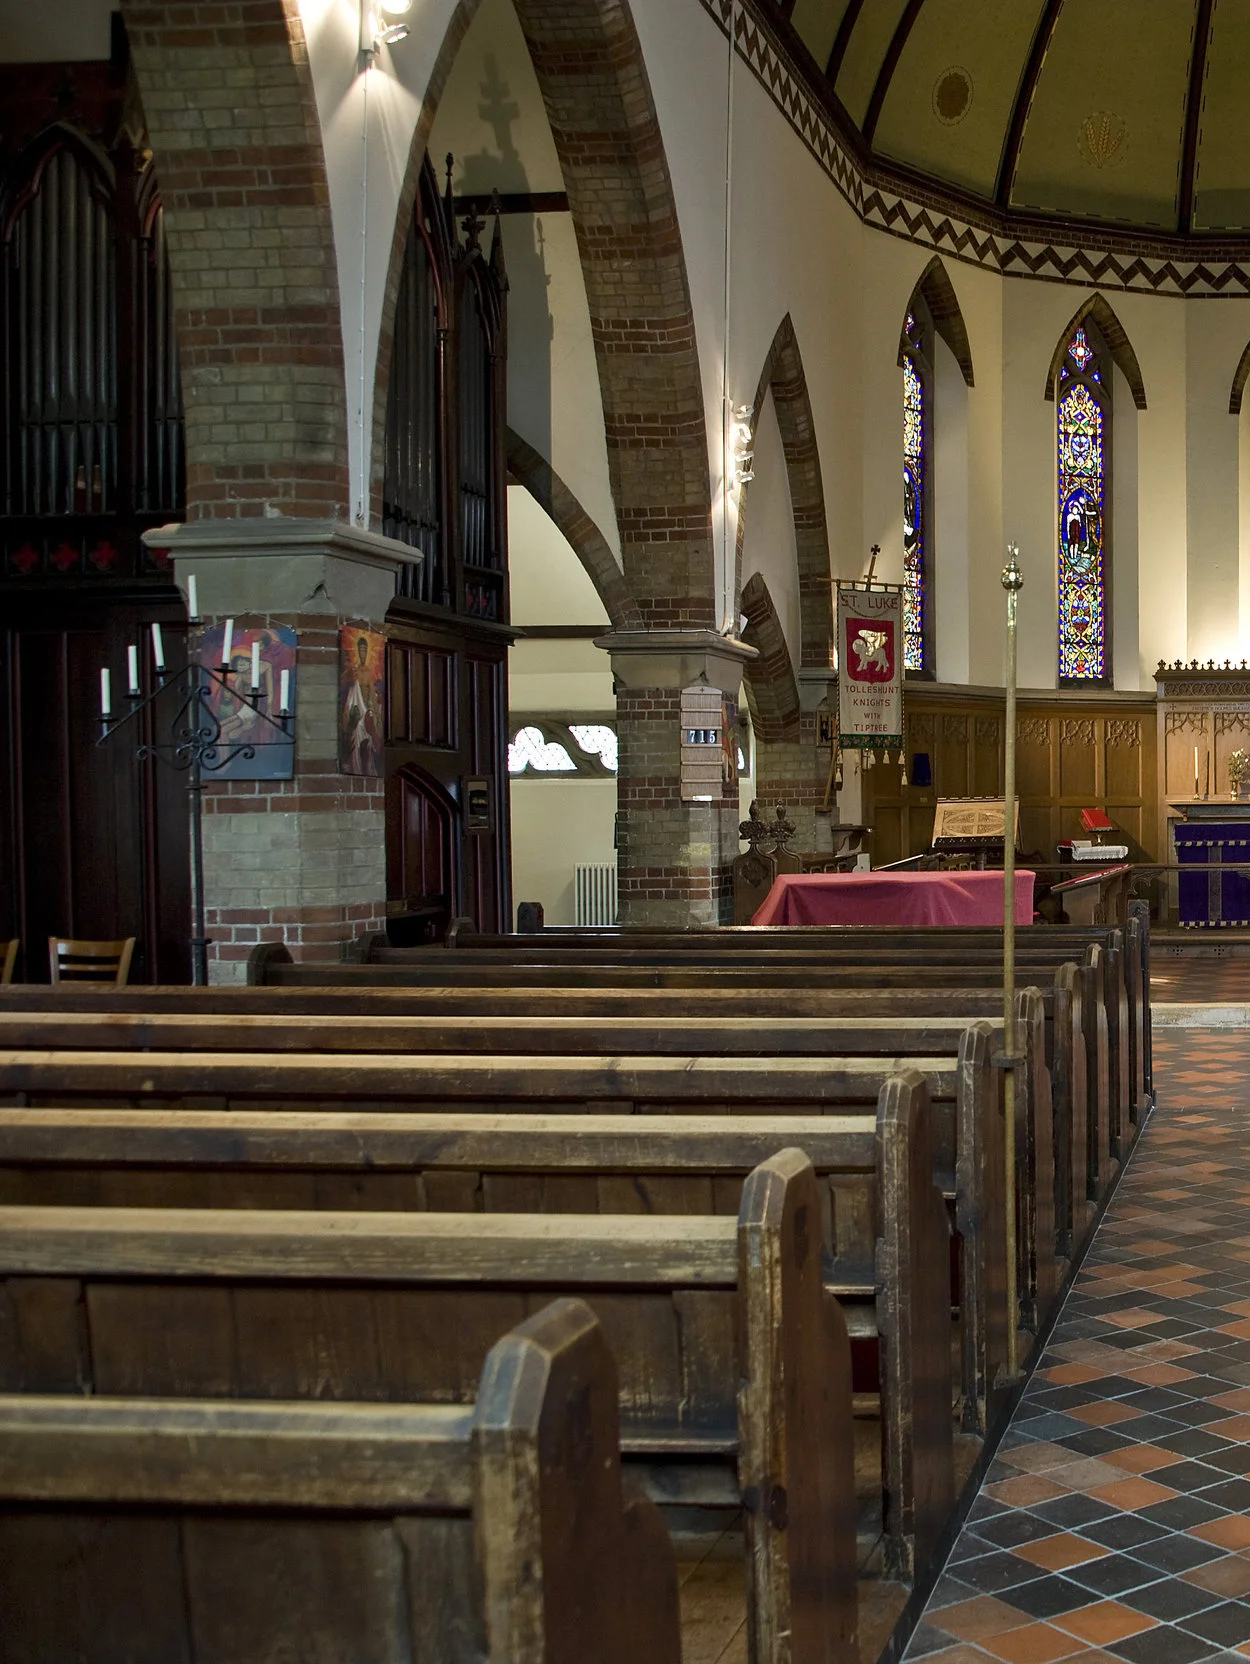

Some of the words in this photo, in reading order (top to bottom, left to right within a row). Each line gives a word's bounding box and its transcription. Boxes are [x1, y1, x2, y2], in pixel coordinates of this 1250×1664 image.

[841, 594, 860, 608] ST.
[868, 597, 898, 609] LUKE
[845, 685, 899, 694] TOLLESHUNT
[852, 699, 891, 707] KNIGHTS
[863, 712, 881, 720] WITH
[853, 723, 888, 732] TIPTREE
[690, 730, 716, 743] 715
